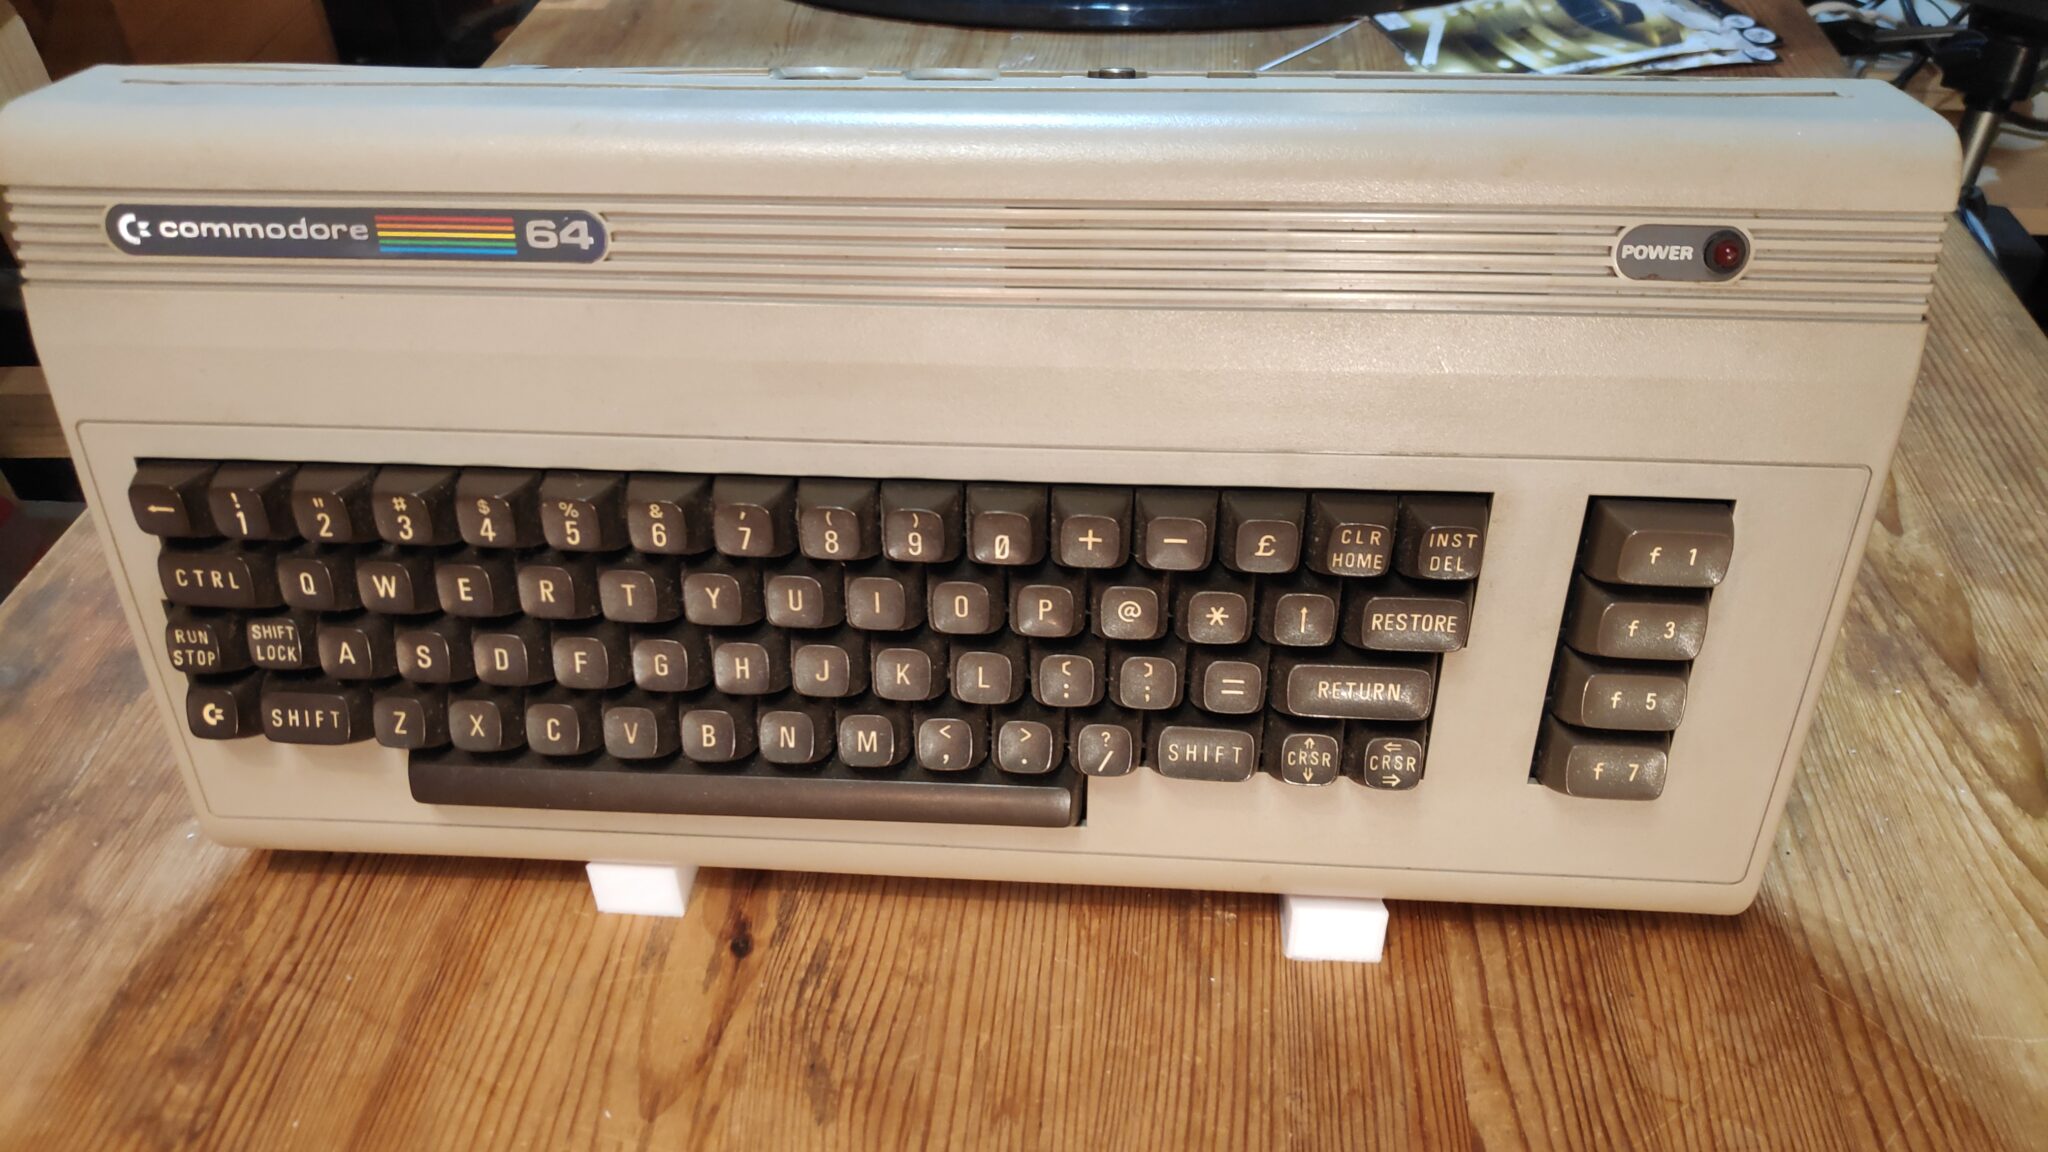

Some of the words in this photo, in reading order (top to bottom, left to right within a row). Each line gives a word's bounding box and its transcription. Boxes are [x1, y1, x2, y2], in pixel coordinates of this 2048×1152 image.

[159, 217, 369, 241] commodore
[524, 218, 595, 250] 64
[1621, 243, 1694, 262] POWER
[231, 492, 240, 508] !
[393, 497, 407, 511] #
[477, 498, 490, 515] $
[559, 502, 579, 518] %
[650, 504, 663, 518] &
[236, 511, 247, 535] 1
[318, 513, 333, 537] 2
[397, 515, 413, 540] 3
[826, 511, 832, 526] (
[913, 514, 918, 528] )
[480, 519, 496, 542] 4
[565, 521, 580, 545] 5
[652, 523, 667, 547] 6
[738, 527, 751, 550] 7
[824, 530, 839, 553] 8
[1078, 529, 1102, 550] +
[1341, 530, 1382, 546] CLR
[1429, 533, 1478, 549] INST
[908, 532, 922, 556] 9
[1255, 535, 1276, 557] £
[1332, 552, 1383, 570] HOME
[1429, 556, 1465, 571] DEL
[1650, 547, 1662, 564] f
[1689, 548, 1698, 566] 1
[175, 569, 240, 590] CTRL
[300, 572, 317, 595] Q
[372, 574, 396, 597] W
[458, 578, 473, 601] E
[540, 579, 556, 603] R
[621, 584, 635, 606] T
[705, 587, 720, 609] Y
[788, 589, 802, 611] U
[875, 592, 880, 613] I
[954, 595, 968, 617] O
[1038, 600, 1052, 621] P
[1118, 600, 1141, 622] @
[252, 624, 295, 641] SHIFT
[1371, 613, 1458, 634] RESTORE
[1628, 620, 1639, 637] f
[1664, 622, 1676, 639] 3
[175, 629, 209, 645] RUN
[173, 650, 216, 666] STOP
[256, 645, 298, 662] LOCK
[339, 642, 356, 665] A
[417, 645, 431, 668] S
[495, 648, 509, 671] D
[574, 651, 588, 673] F
[654, 654, 669, 676] G
[735, 657, 749, 679] H
[815, 659, 829, 682] J
[896, 663, 910, 685] K
[978, 666, 990, 688] L
[1221, 679, 1245, 695] =
[1318, 681, 1401, 701] RETURN
[1611, 692, 1622, 708] f
[1646, 693, 1657, 710] 5
[272, 708, 340, 728] SHIFT
[393, 711, 407, 734] Z
[469, 715, 485, 737] X
[547, 718, 561, 741] C
[623, 722, 638, 744] V
[702, 725, 716, 747] B
[780, 726, 795, 748] N
[939, 725, 952, 739] <
[1020, 728, 1033, 742] >
[1101, 731, 1111, 747] ?
[857, 731, 878, 752] M
[1098, 750, 1114, 772] /
[1168, 743, 1243, 764] SHIFT
[1287, 751, 1331, 767] CRSR
[1369, 755, 1416, 772] CRSR
[1594, 762, 1604, 780] f
[1628, 764, 1639, 782] 7
